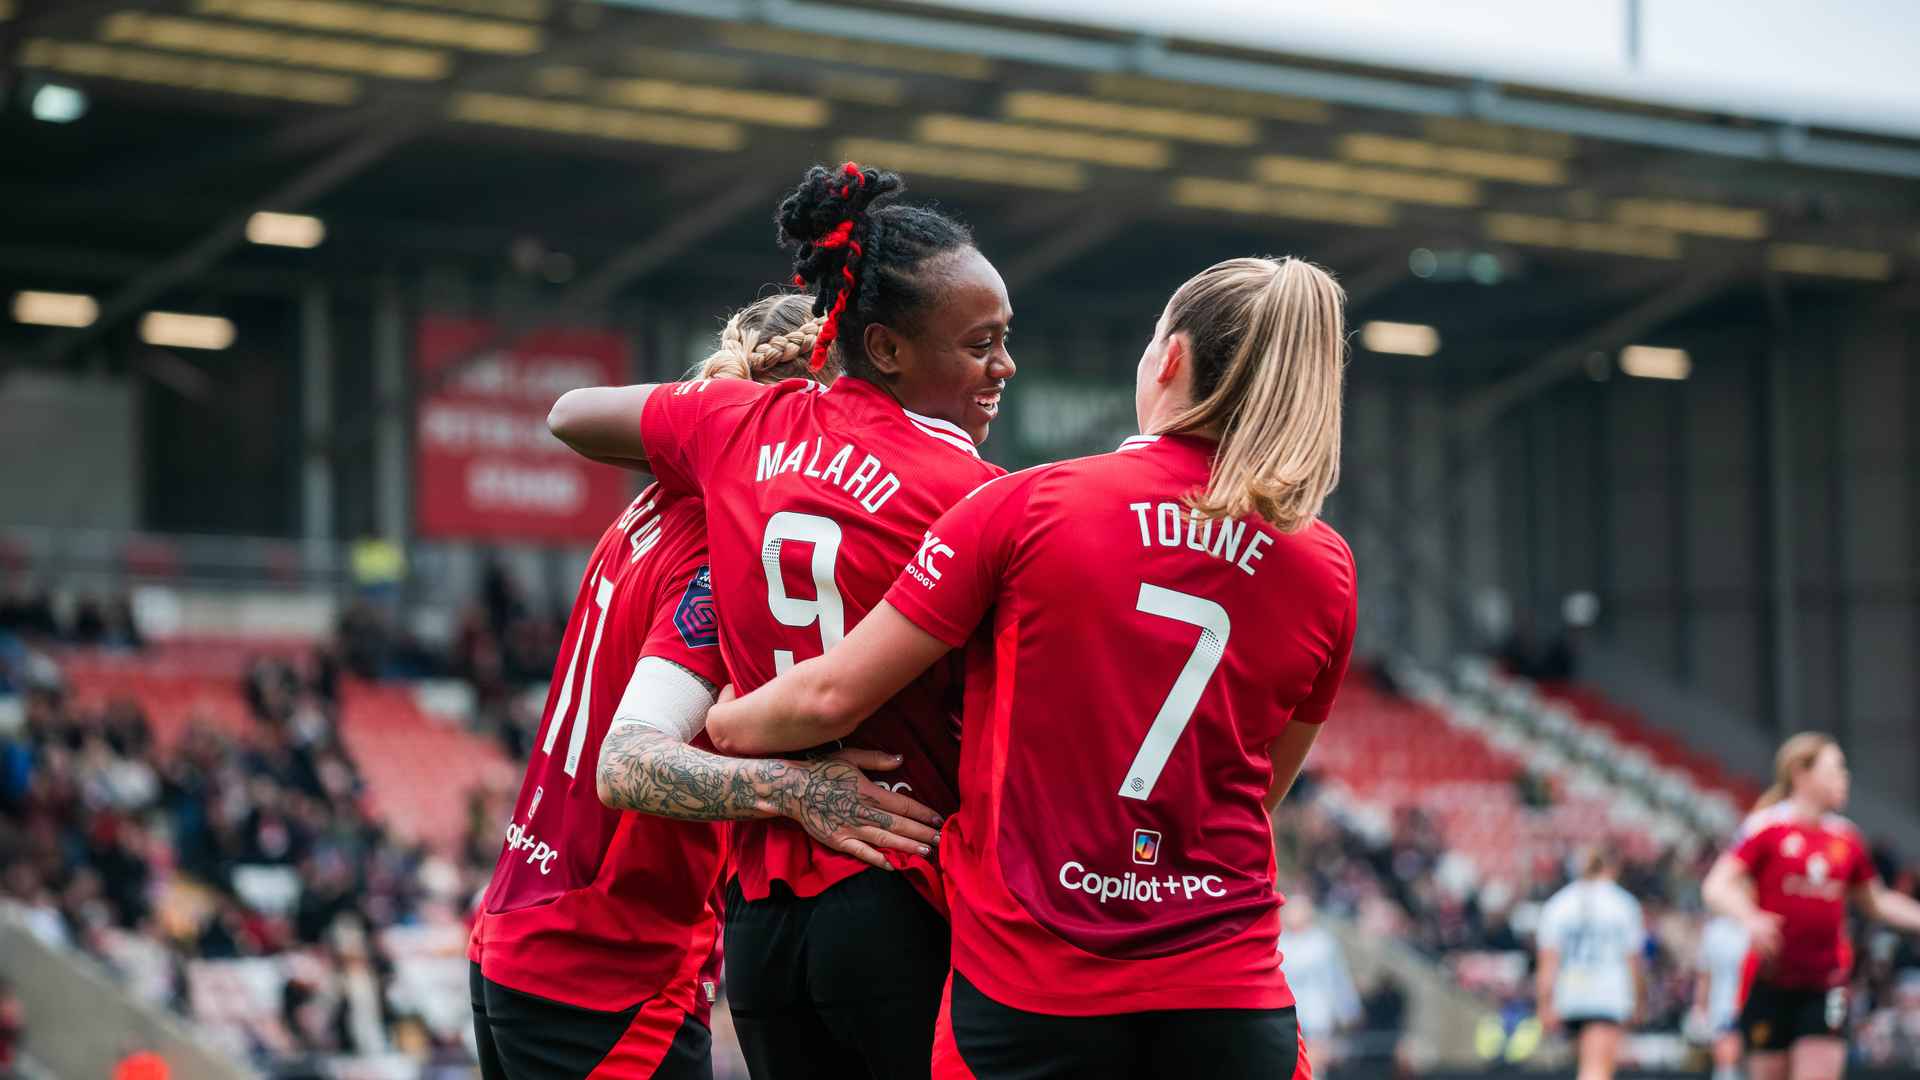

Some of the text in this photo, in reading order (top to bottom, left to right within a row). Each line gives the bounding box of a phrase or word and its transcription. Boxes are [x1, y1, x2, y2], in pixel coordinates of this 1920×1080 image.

[756, 436, 901, 514] MALARD
[905, 563, 936, 590] OLOGY
[917, 530, 956, 580] XC
[1129, 502, 1275, 576] TOONE
[761, 511, 845, 681] 9
[542, 559, 616, 779] 11
[1118, 582, 1231, 801] 7
